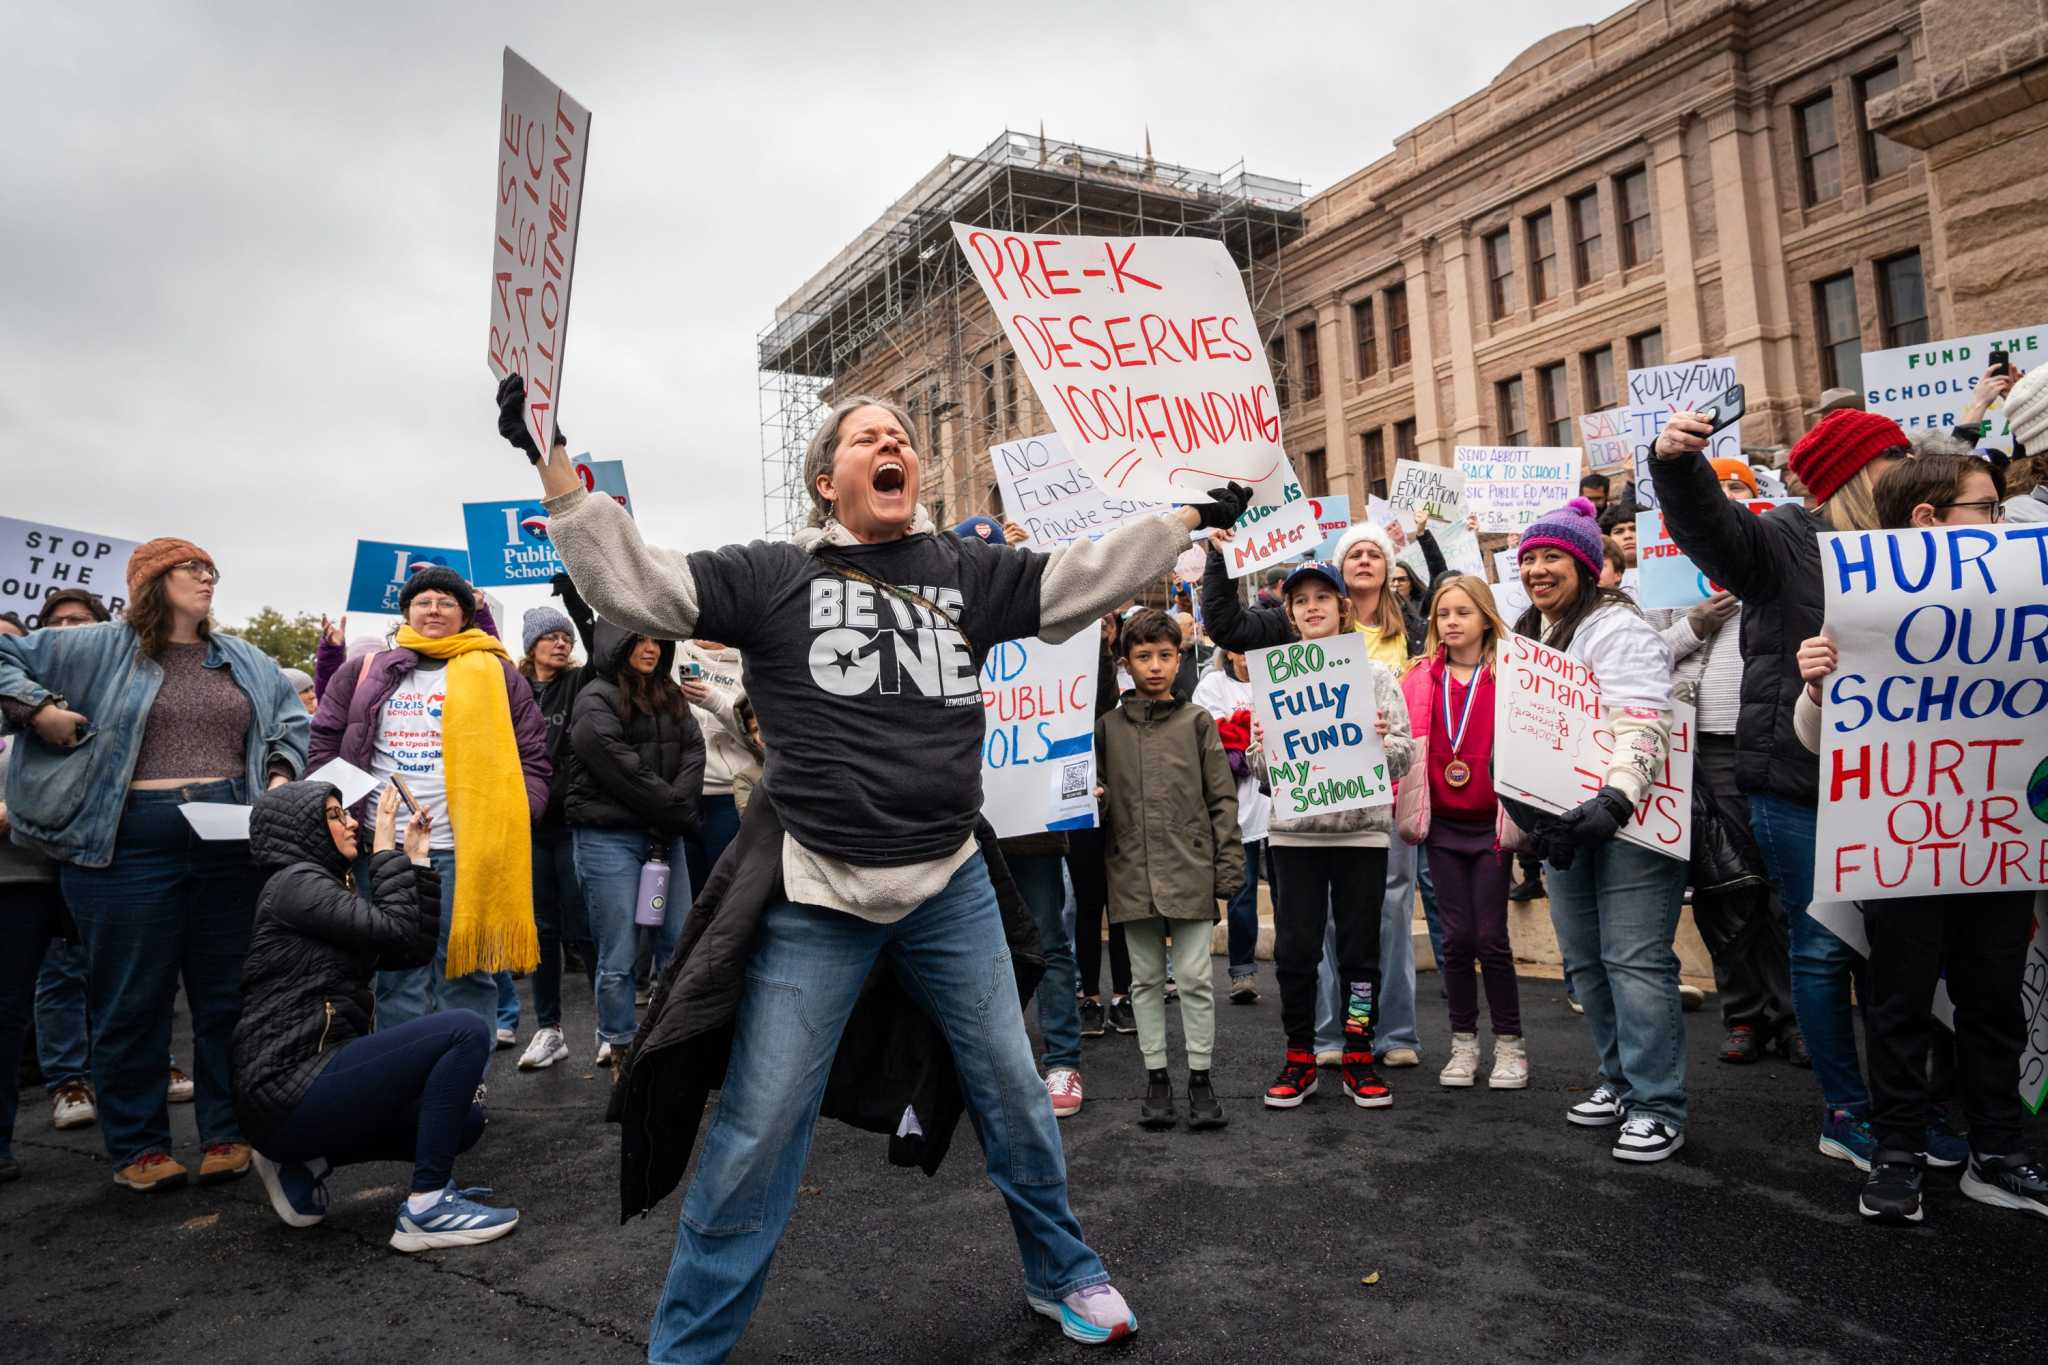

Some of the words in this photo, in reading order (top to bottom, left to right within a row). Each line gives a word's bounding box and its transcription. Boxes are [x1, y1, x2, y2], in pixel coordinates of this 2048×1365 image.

[490, 103, 522, 373] RAISE
[510, 120, 545, 398] BASIC
[530, 89, 576, 452] ALLOTMENT
[969, 231, 1163, 301] PRE-K
[1012, 313, 1252, 371] DESERVES
[1908, 347, 1971, 369] FUND
[1990, 335, 2038, 353] THE
[1867, 376, 1980, 404] SCHOOLS
[1053, 383, 1144, 444] 100%
[1136, 385, 1280, 457] FUNDING
[1001, 440, 1049, 476] NO
[1458, 448, 1487, 461] SEND
[1504, 464, 1516, 480] TO
[1013, 467, 1094, 511] Funds
[1397, 481, 1459, 505] EDUCATION
[1406, 468, 1446, 489] EQUAL
[1467, 486, 1482, 499] SIC
[1390, 496, 1414, 512] FOR
[1423, 501, 1444, 519] ALL
[500, 508, 525, 545] I
[1024, 510, 1102, 545] Private
[26, 531, 111, 559] STOP
[503, 545, 561, 564] Public
[1234, 524, 1305, 568] Matter
[1643, 544, 1684, 560] PUB
[1830, 529, 2048, 594] HURT
[30, 556, 93, 584] THE
[391, 550, 412, 583] I
[505, 562, 563, 579] Schools
[810, 578, 878, 629] BE
[1894, 604, 2048, 665] OUR
[985, 640, 1027, 682] ND
[1517, 668, 1600, 719] PUBLIC
[1830, 674, 2048, 733] SCHOO
[1283, 723, 1363, 760] FUND
[397, 763, 435, 772] Today!
[1269, 760, 1310, 787] MY
[1829, 739, 2024, 802] HURT
[1887, 796, 2022, 845] OUR
